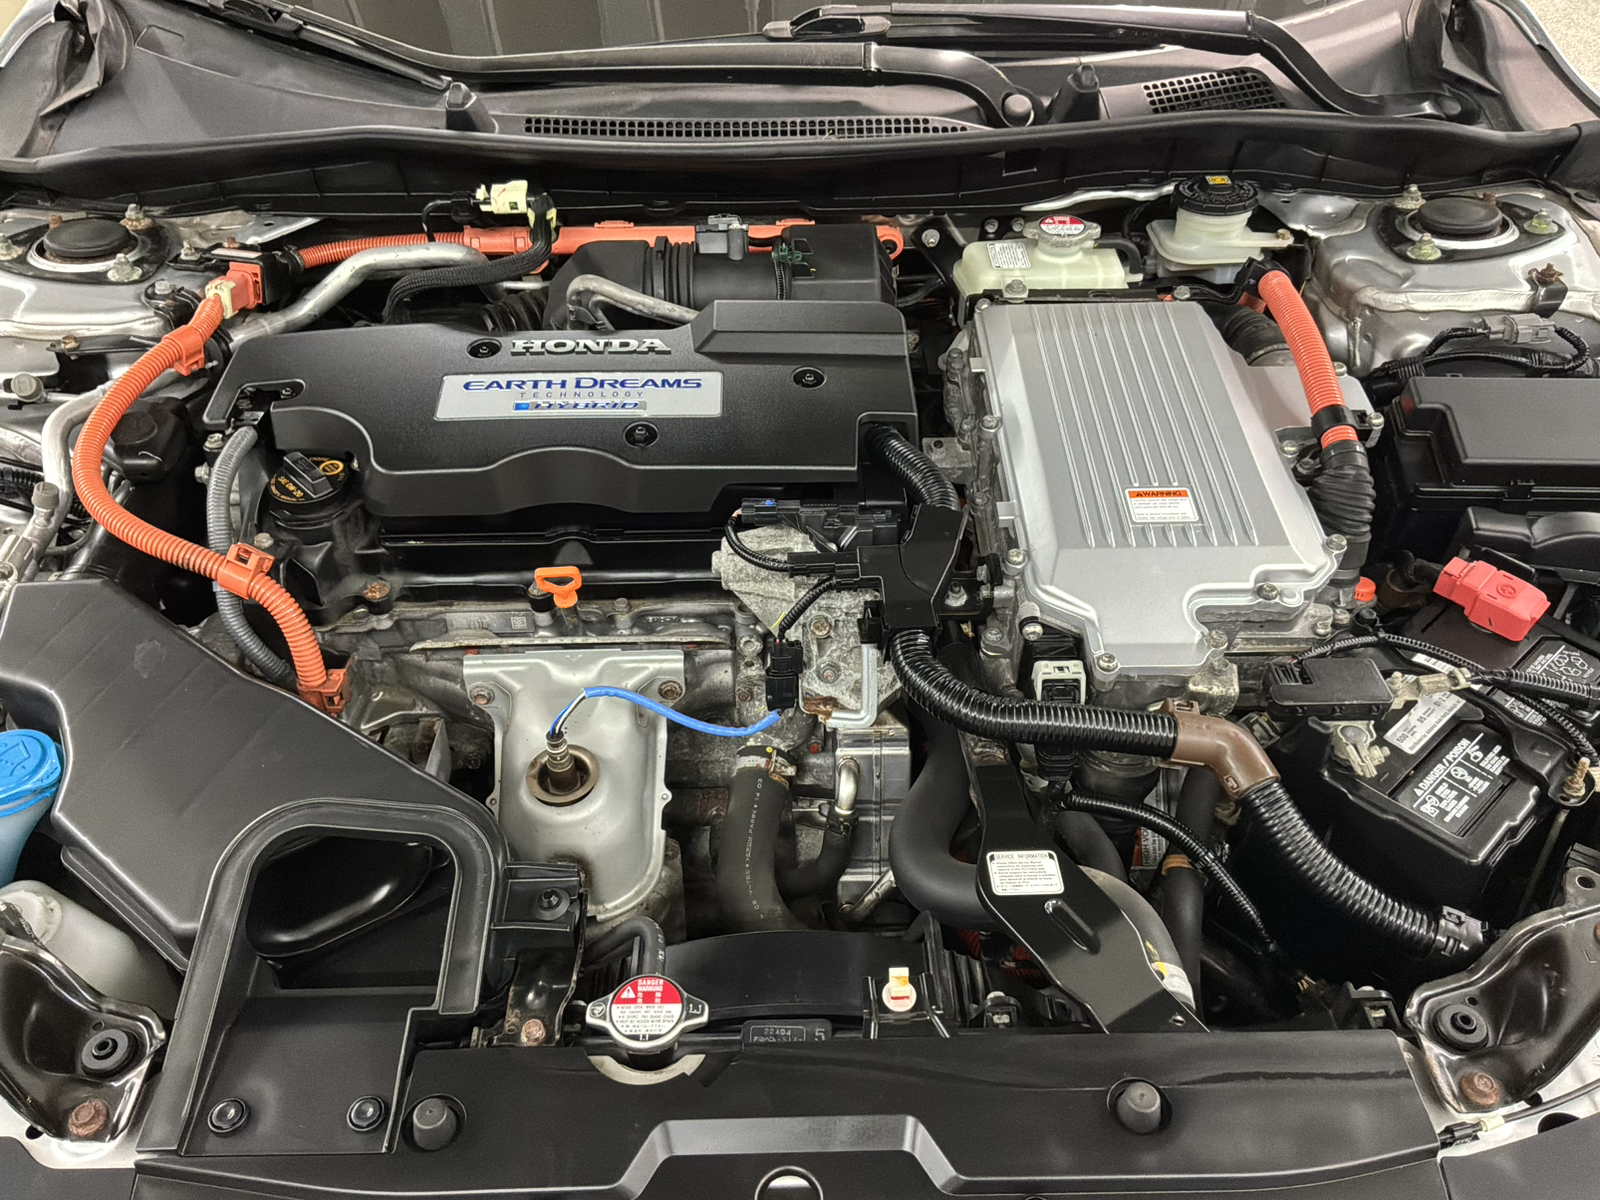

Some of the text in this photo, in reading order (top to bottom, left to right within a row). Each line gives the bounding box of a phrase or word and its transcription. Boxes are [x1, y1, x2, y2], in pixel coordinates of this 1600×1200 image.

[511, 338, 671, 354] HONDA
[463, 377, 702, 391] EARTH DREAMS
[533, 401, 641, 410] HYBRID
[1418, 762, 1446, 791] DANGER
[1446, 736, 1470, 762] POISON
